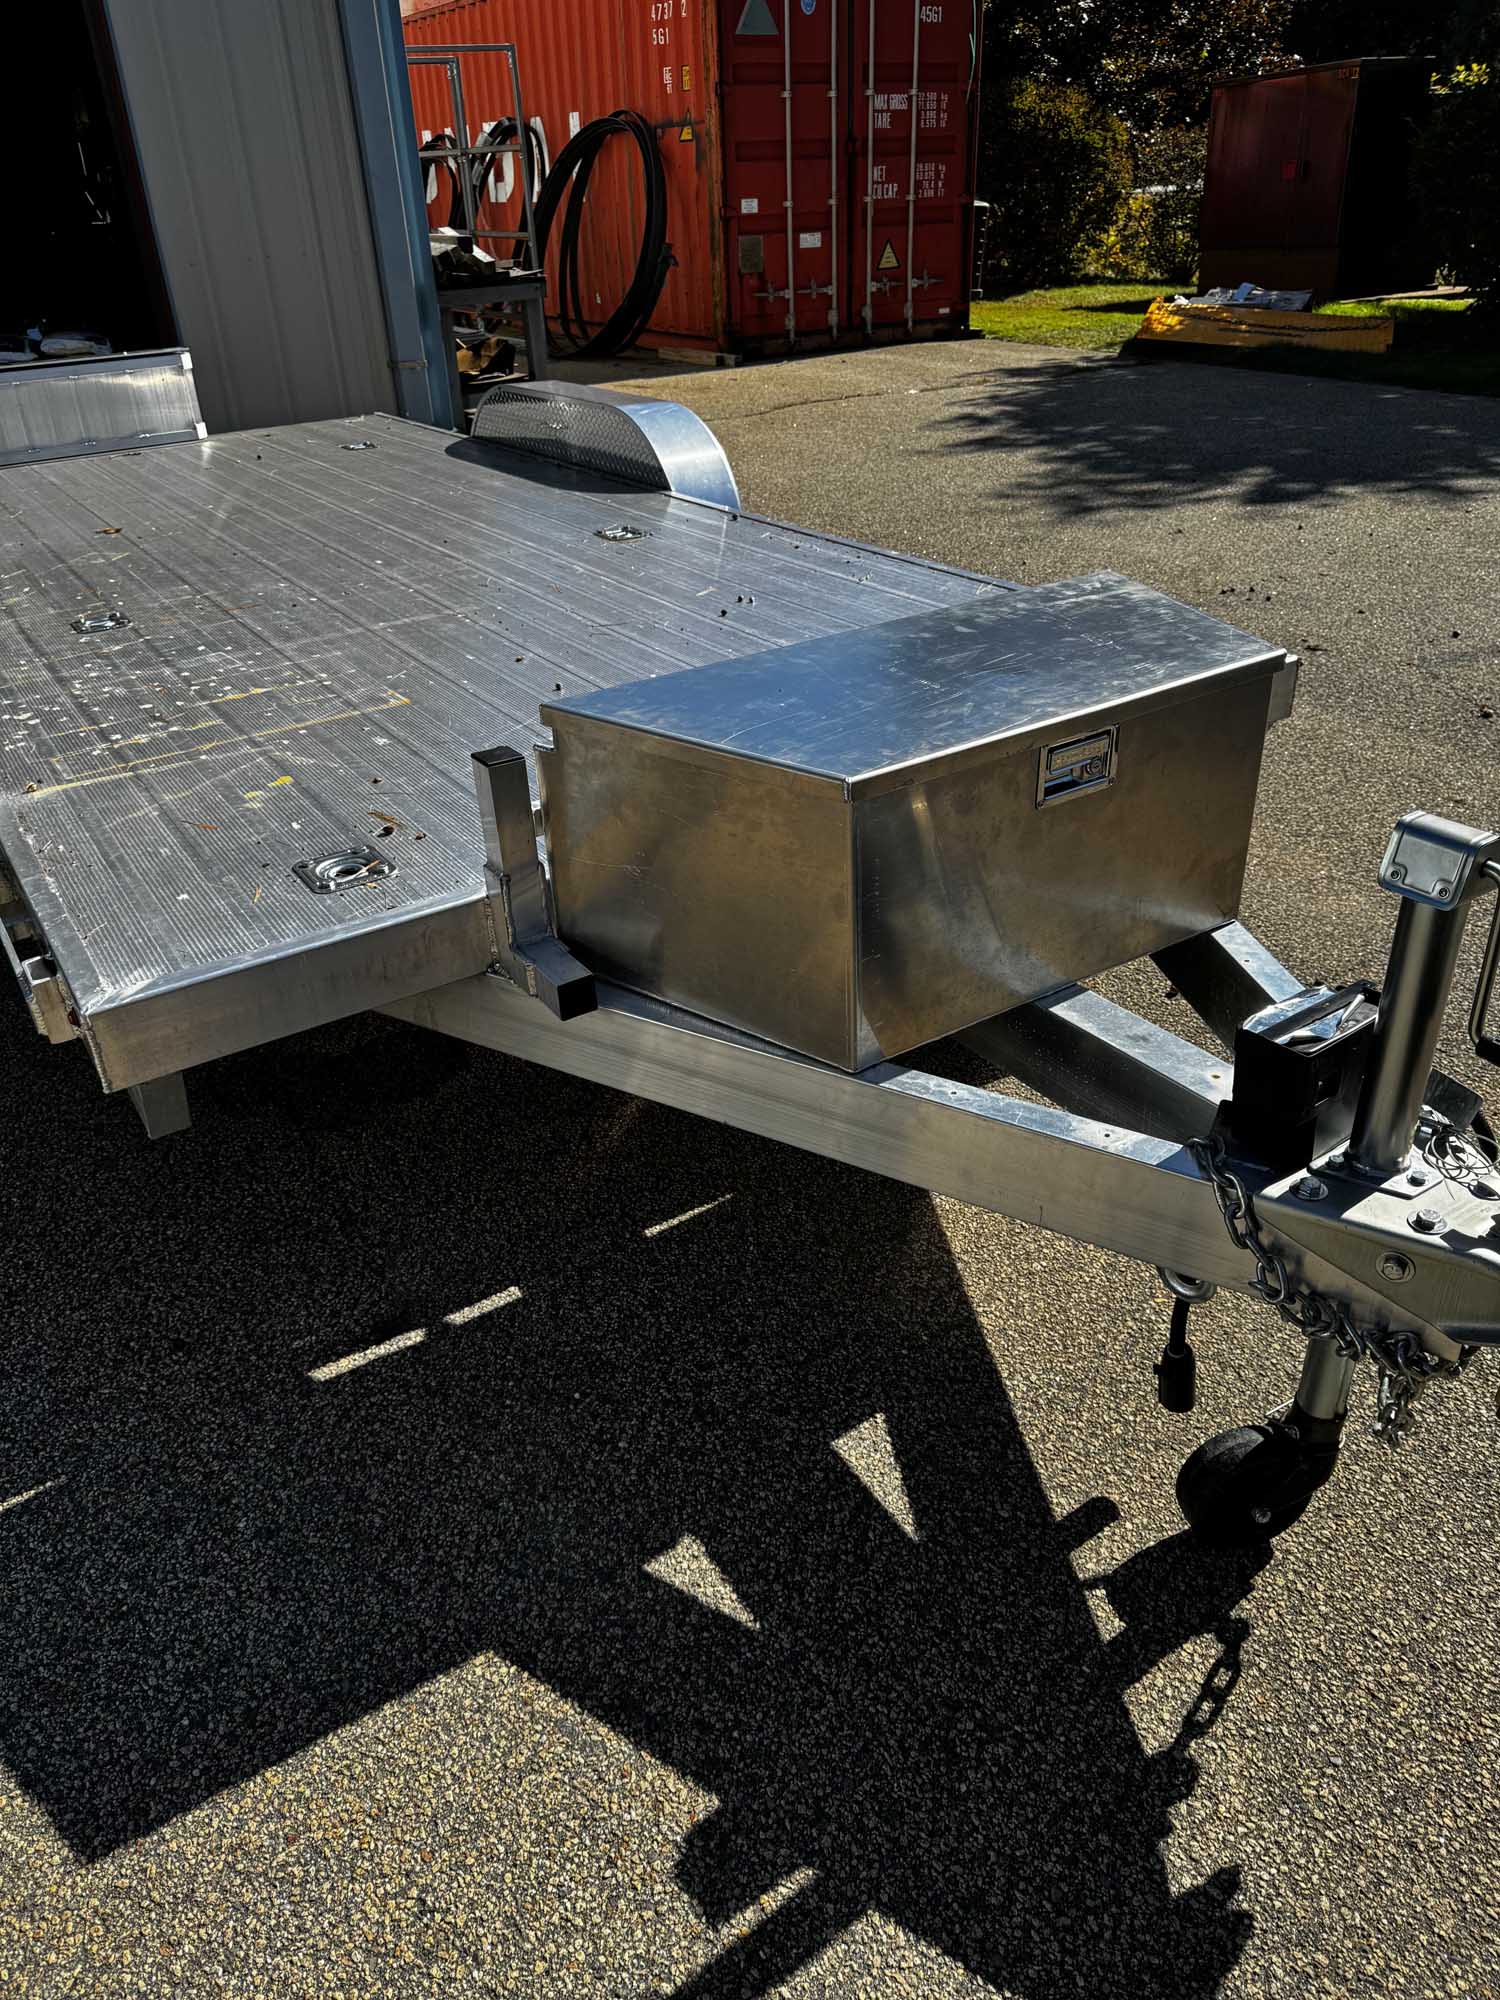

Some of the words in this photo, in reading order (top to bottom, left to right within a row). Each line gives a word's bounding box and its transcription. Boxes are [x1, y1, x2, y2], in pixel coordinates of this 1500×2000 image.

[651, 0, 673, 21] 4737
[920, 6, 943, 23] 45G1
[874, 93, 888, 110] MAX
[889, 93, 908, 110] GROSS
[874, 112, 892, 129] TARE
[873, 165, 887, 181] NET
